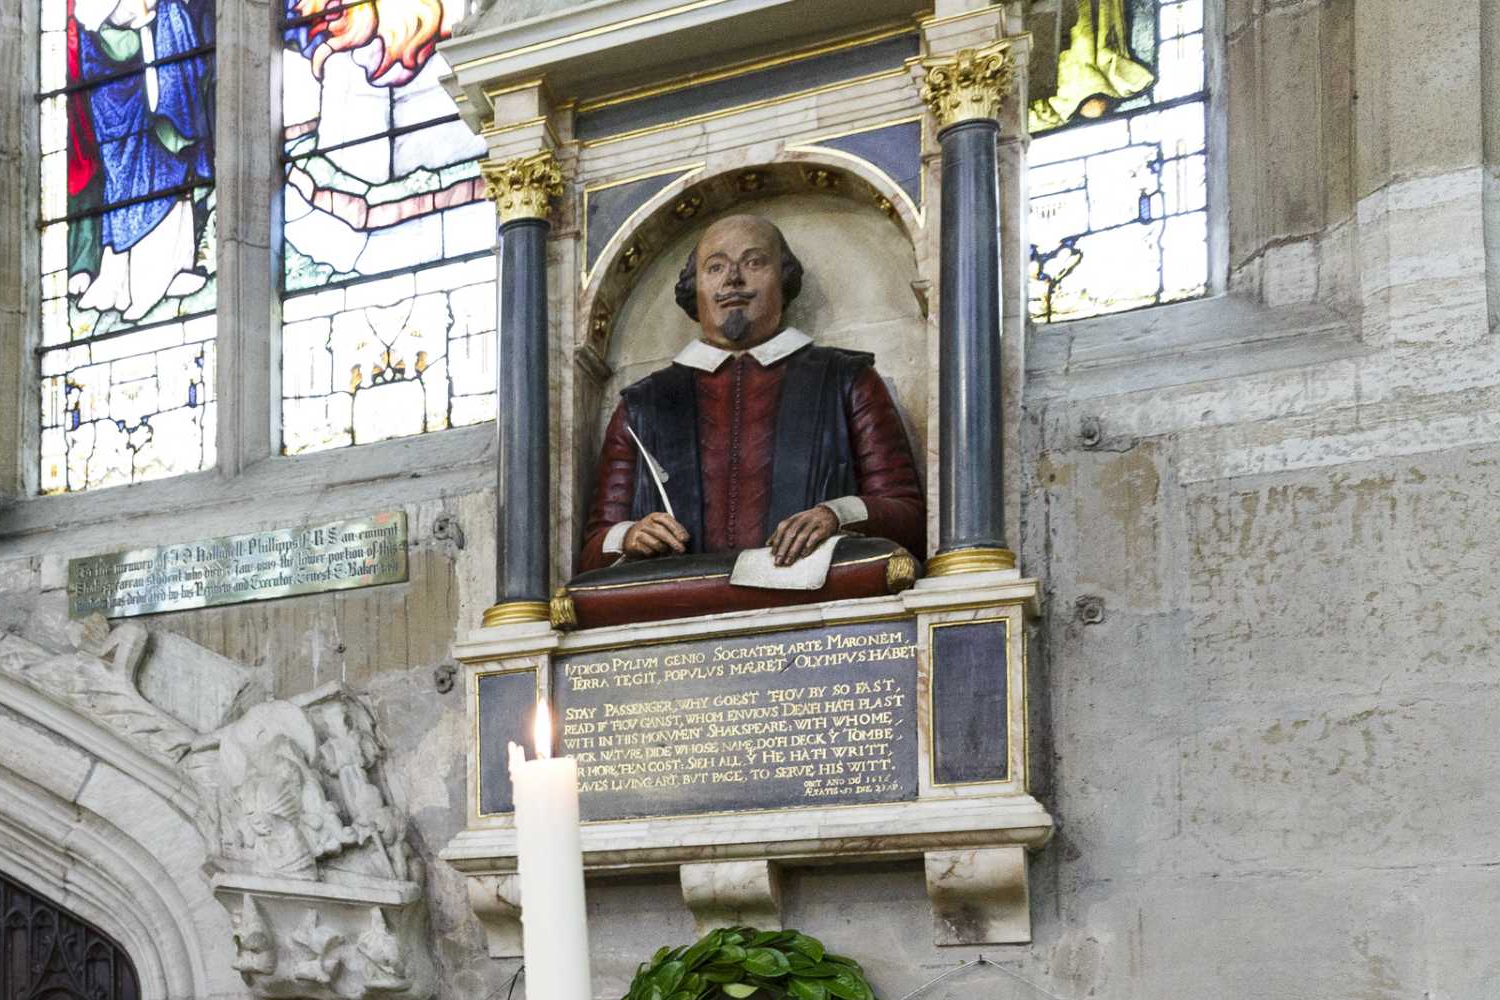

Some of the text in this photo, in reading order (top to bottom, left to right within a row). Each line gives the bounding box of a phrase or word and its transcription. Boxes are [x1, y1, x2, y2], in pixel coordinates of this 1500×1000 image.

[664, 652, 706, 667] GENIO
[787, 639, 823, 654] ARTE
[565, 707, 597, 721] STAY
[678, 697, 709, 710] WHY
[713, 692, 759, 707] GOEST
[809, 685, 826, 698] BY
[832, 683, 850, 696] SO
[564, 722, 595, 736] READ
[685, 711, 724, 724] WHOM
[859, 694, 905, 710] PLAST
[598, 735, 613, 747] IN
[791, 733, 826, 747] DECK
[762, 750, 786, 764] HE
[750, 768, 770, 780] TO
[774, 764, 815, 779] SERVE
[818, 761, 845, 775] HIS
